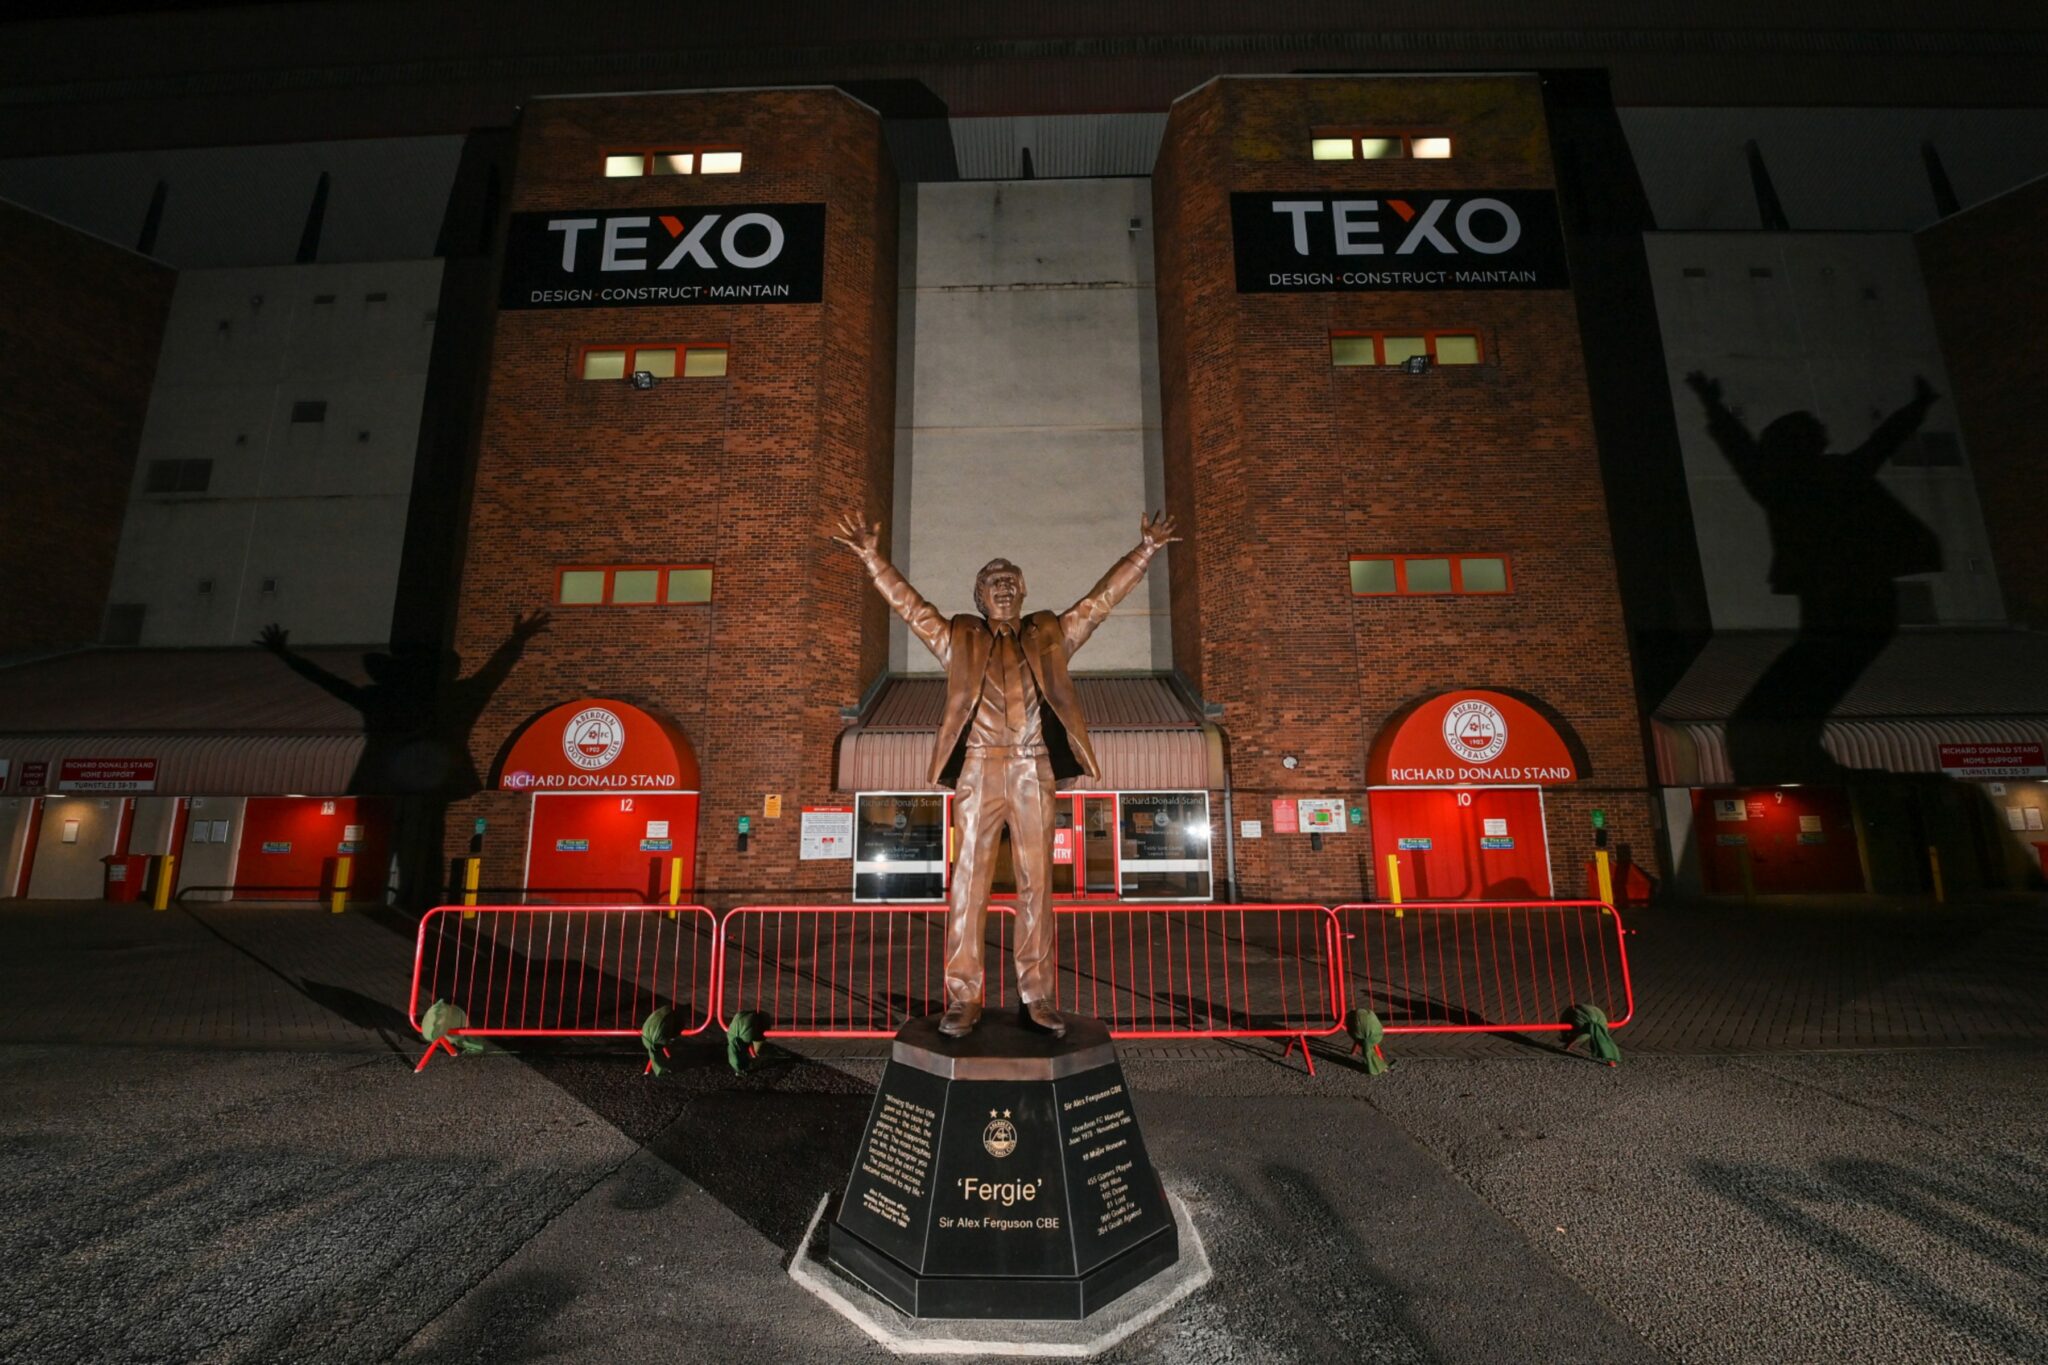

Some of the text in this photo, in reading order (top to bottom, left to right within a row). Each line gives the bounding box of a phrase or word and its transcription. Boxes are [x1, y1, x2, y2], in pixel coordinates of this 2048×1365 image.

[1272, 197, 1521, 256] TEXO
[547, 212, 785, 273] TEXO
[1269, 271, 1536, 286] DESIGN CONSTRUCT MAINTAIN
[530, 284, 789, 302] DESIGN CONSTRUCT MAINTAIN
[1452, 703, 1496, 718] ABERDEEN
[575, 711, 616, 726] ABERDEEN
[567, 740, 620, 766] FOOTBALL CLUB
[1448, 733, 1503, 759] FOOTBALL CLUB
[1987, 756, 2023, 764] SUPPORT
[503, 774, 676, 787] RICHARD DONALD STAND
[1391, 767, 1571, 781] RICHARD DONALD STAND
[860, 798, 942, 807] Richard Donald Stand
[1120, 797, 1150, 805] Richard
[1152, 797, 1180, 805] Donald
[1457, 793, 1472, 806] 10
[1774, 791, 1784, 804] 9
[323, 801, 335, 814] 13
[620, 799, 633, 812] 12
[1053, 847, 1072, 860] NTRY
[1064, 1084, 1122, 1111] Sir Alex Ferguson CBE
[1071, 1109, 1125, 1134] Aberdeen FC Manager
[1068, 1136, 1081, 1146] June
[1096, 1121, 1120, 1134] November
[1089, 1147, 1105, 1158] Major
[1105, 1138, 1127, 1152] Honours
[1097, 1169, 1115, 1182] Games
[1115, 1159, 1133, 1173] Played
[1109, 1176, 1122, 1186] Won
[1111, 1184, 1129, 1196] Drawn
[1114, 1194, 1127, 1206] Lost
[1111, 1206, 1127, 1218] Goals
[1126, 1201, 1135, 1210] For
[938, 1217, 1060, 1231] Sir Alex Ferguson CBE
[1108, 1218, 1124, 1230] Goals
[1123, 1207, 1143, 1223] Against
